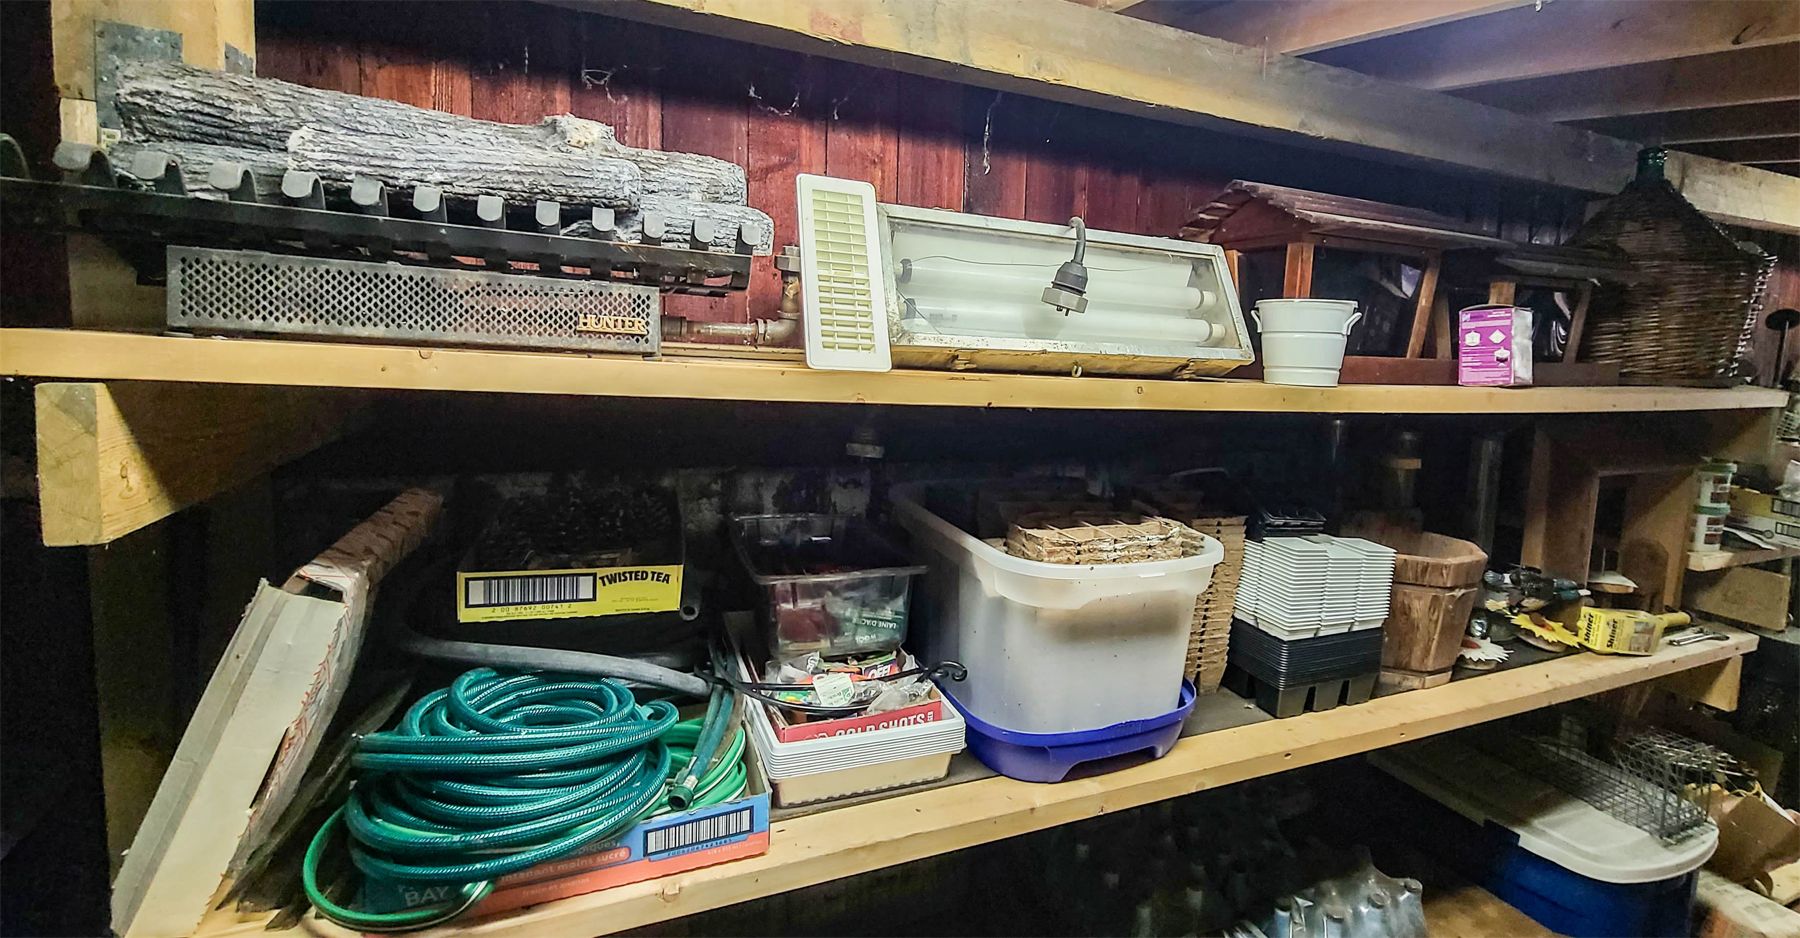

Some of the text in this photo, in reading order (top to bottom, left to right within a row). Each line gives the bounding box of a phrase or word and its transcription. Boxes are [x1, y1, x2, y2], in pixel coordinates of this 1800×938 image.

[578, 314, 646, 333] HUNTER
[599, 571, 671, 587] TWISTED TEA
[878, 620, 897, 629] LAINE
[1584, 612, 1594, 644] Shiner
[1606, 619, 1618, 649] Shiner
[868, 664, 892, 679] OFF!
[879, 713, 926, 729] SHOTS
[557, 856, 597, 872] moins
[599, 849, 627, 864] sucré
[404, 886, 449, 906] BAY
